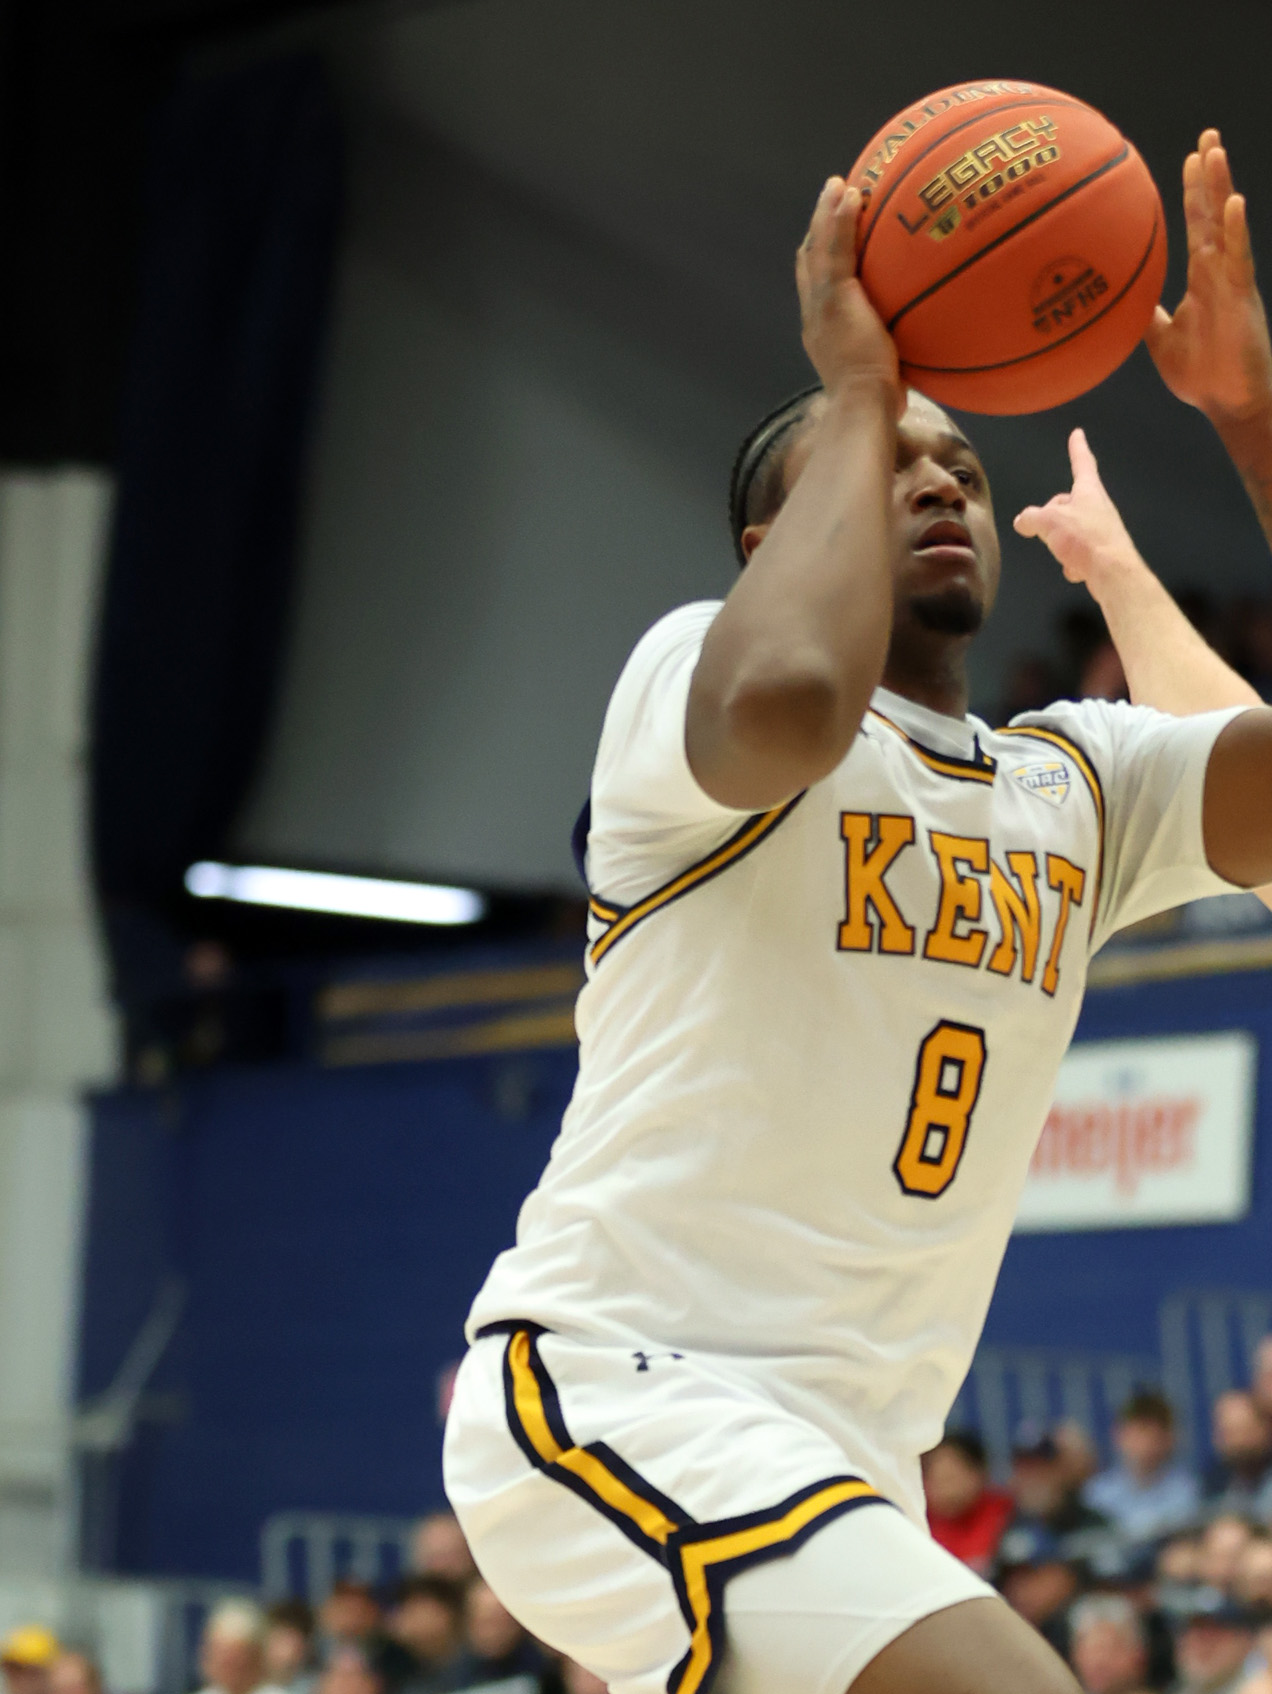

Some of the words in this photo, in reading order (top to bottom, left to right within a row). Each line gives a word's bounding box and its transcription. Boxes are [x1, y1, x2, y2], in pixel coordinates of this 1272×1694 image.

[897, 115, 1058, 235] LEGACY
[962, 145, 1060, 208] 1000
[836, 811, 1085, 997] KENT
[892, 1018, 986, 1199] 8
